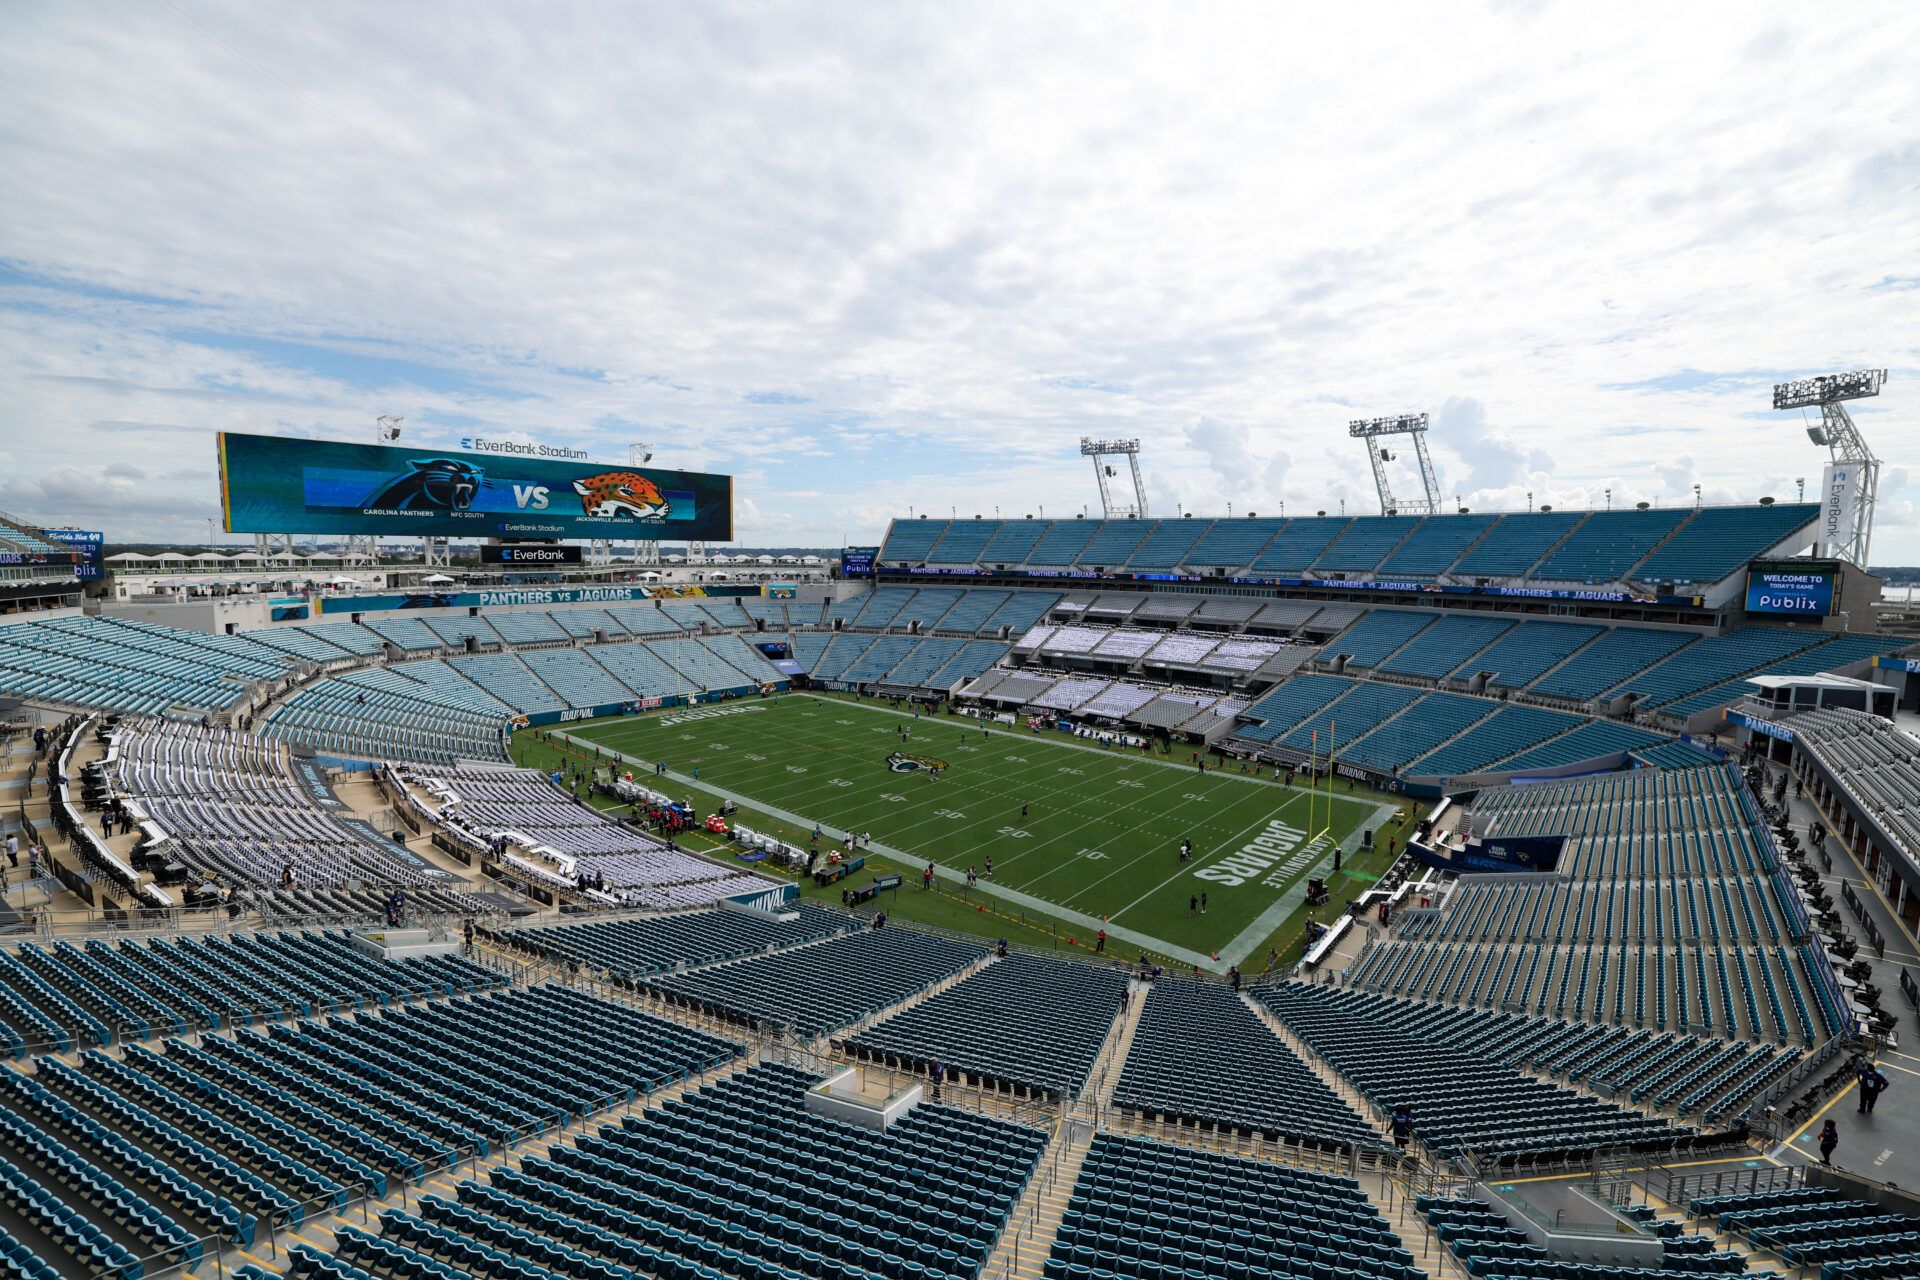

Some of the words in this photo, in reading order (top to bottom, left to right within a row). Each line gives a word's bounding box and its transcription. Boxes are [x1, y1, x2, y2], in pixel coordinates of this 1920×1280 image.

[475, 438, 536, 455] EverBank
[538, 444, 588, 459] Stadium
[513, 485, 550, 509] VS
[363, 508, 399, 516] CAROLINA
[1827, 484, 1845, 538] EverBank
[505, 523, 537, 531] EverBank
[0, 553, 22, 564] UARS
[513, 549, 564, 560] EverBank
[1763, 574, 1808, 583] WELCOME
[1809, 575, 1823, 583] TO
[1323, 580, 1364, 588] PANTHERS
[1378, 582, 1417, 591] JAGUARS
[479, 591, 553, 606] PANTHERS
[576, 589, 632, 602] JAGUARS
[1500, 587, 1553, 598] PANTHERS
[1572, 591, 1624, 601] JAGUARS
[1759, 595, 1817, 610] Publix
[1449, 778, 1494, 789] EverB
[933, 808, 963, 819] 30
[996, 826, 1029, 838] 20
[1076, 848, 1105, 860] 10
[1193, 819, 1308, 886] JAGUARS
[1261, 837, 1332, 889] JACKSONVILLE
